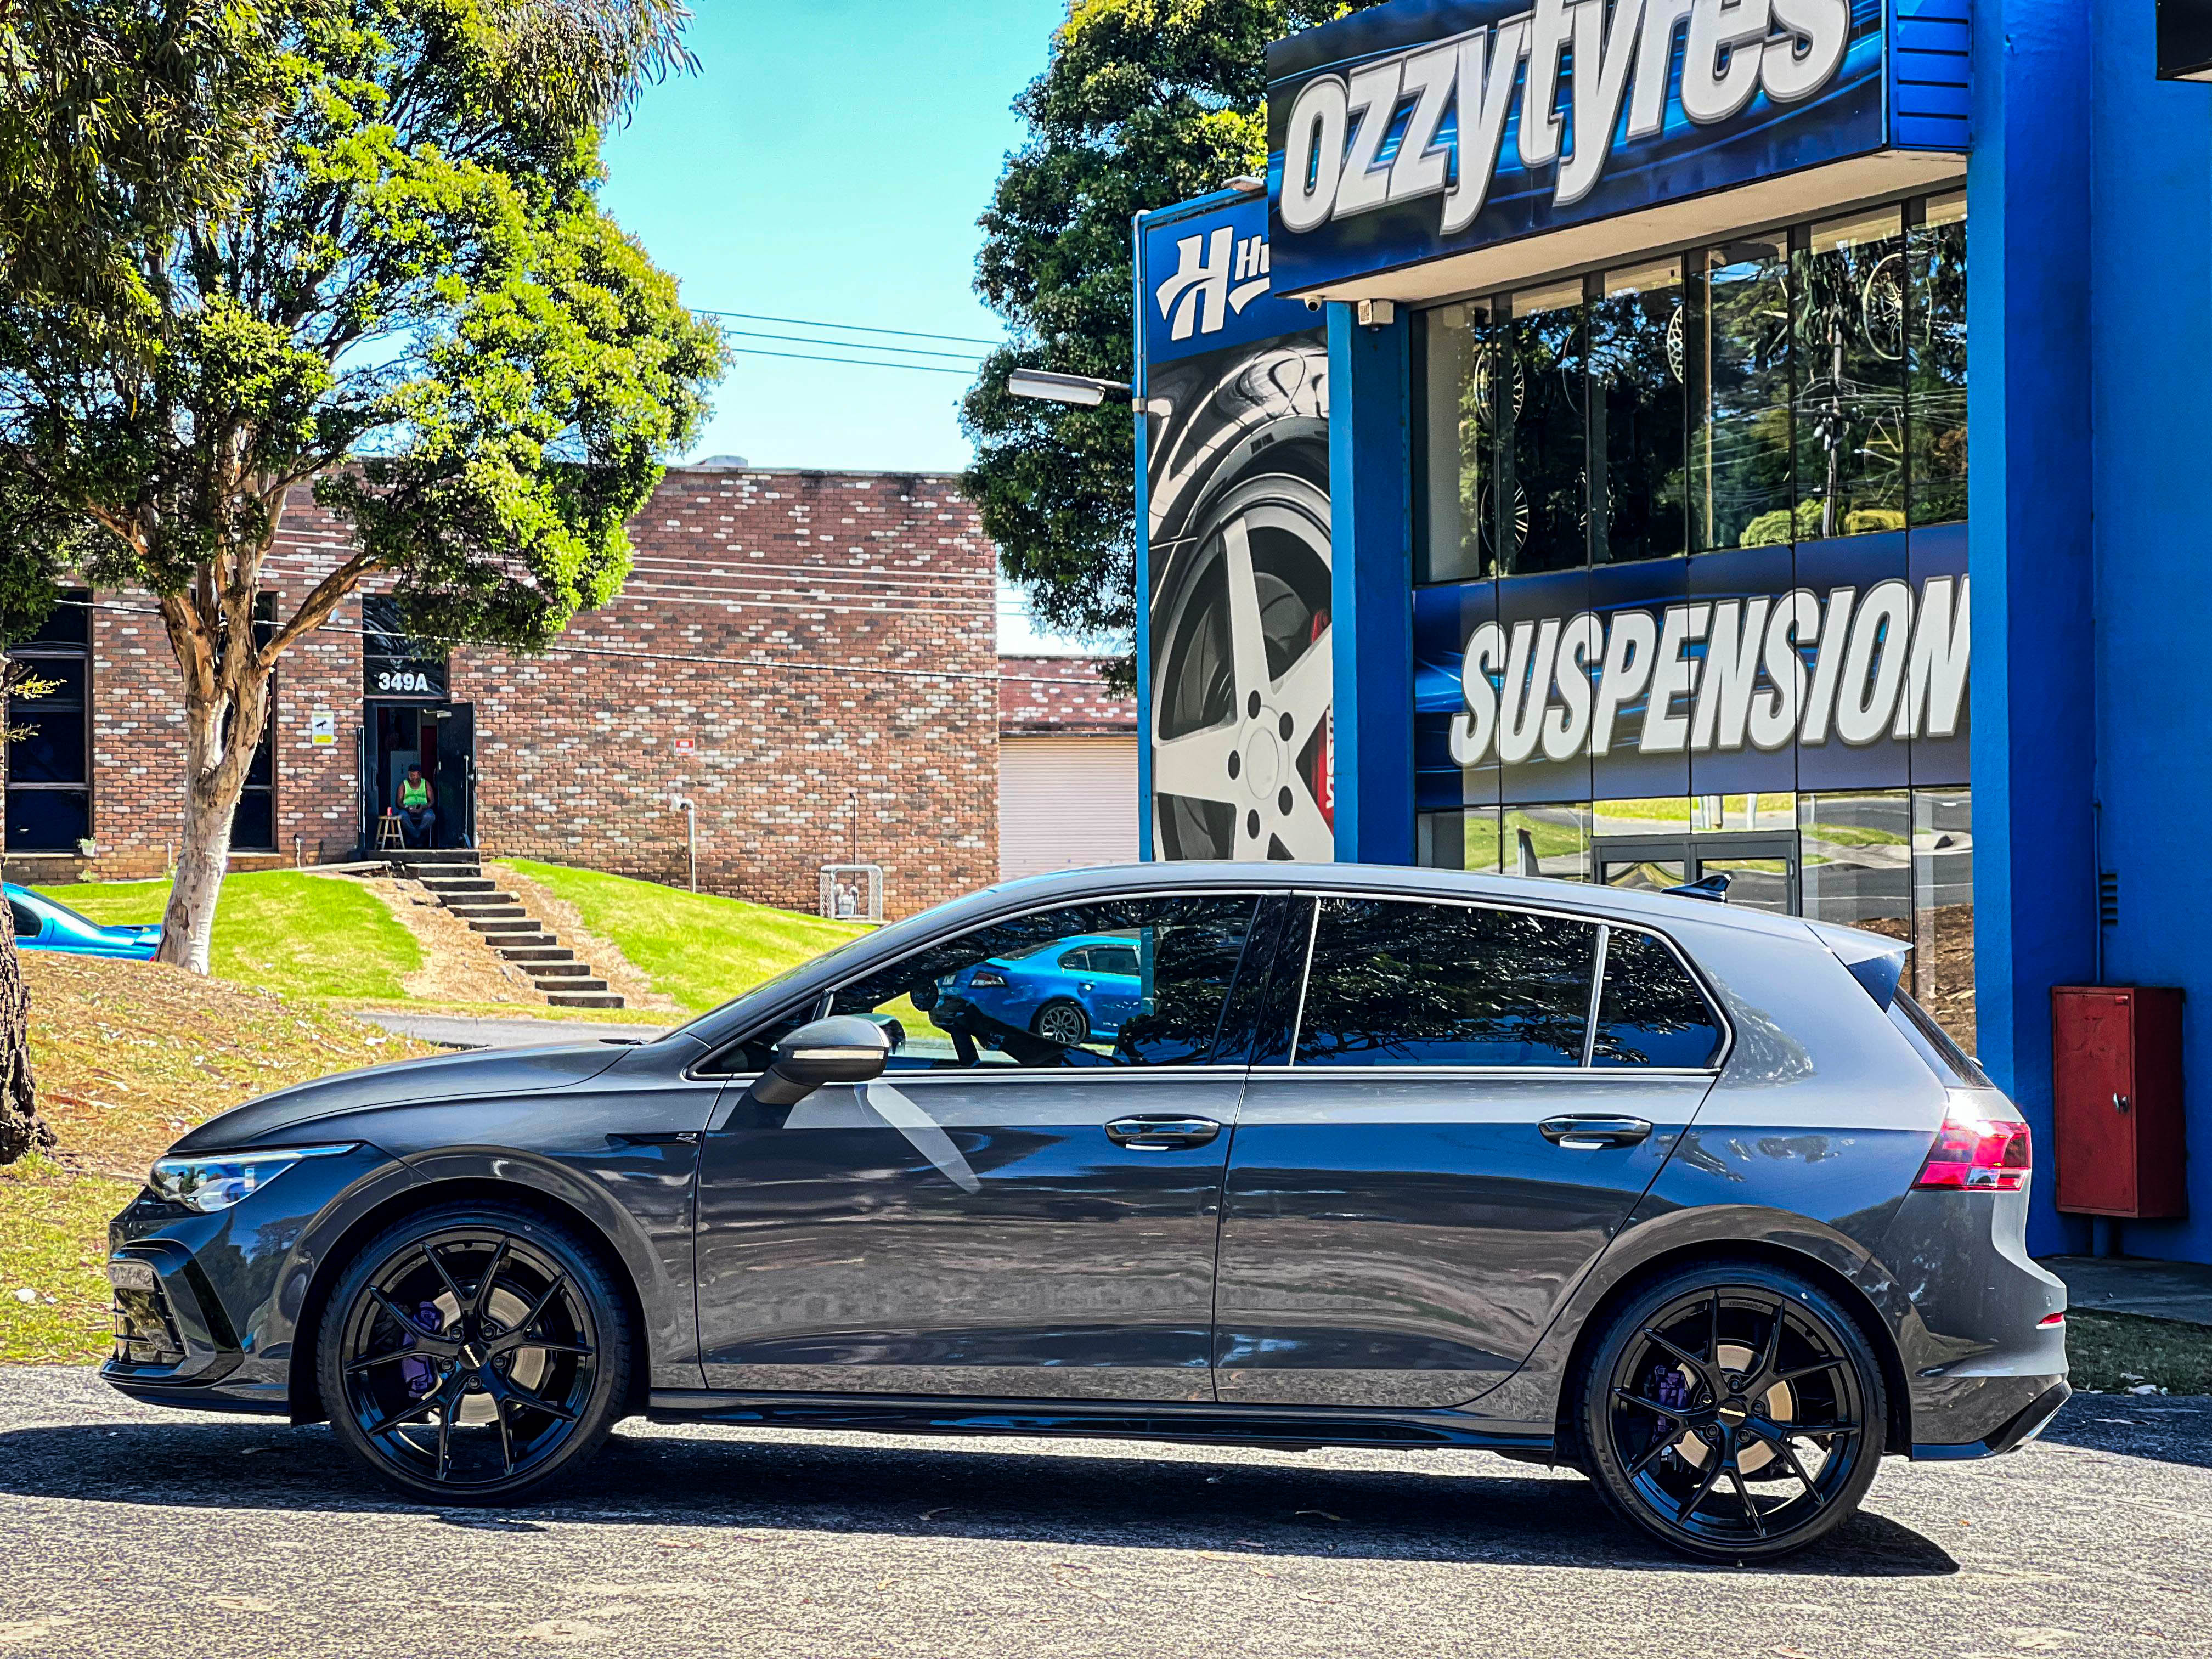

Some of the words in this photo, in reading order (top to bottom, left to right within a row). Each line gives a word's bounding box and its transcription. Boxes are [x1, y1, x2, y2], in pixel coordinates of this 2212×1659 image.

[1280, 0, 1849, 236] ozzytyres
[379, 672, 428, 691] 349A
[1449, 574, 1971, 768] SUSPENSION
